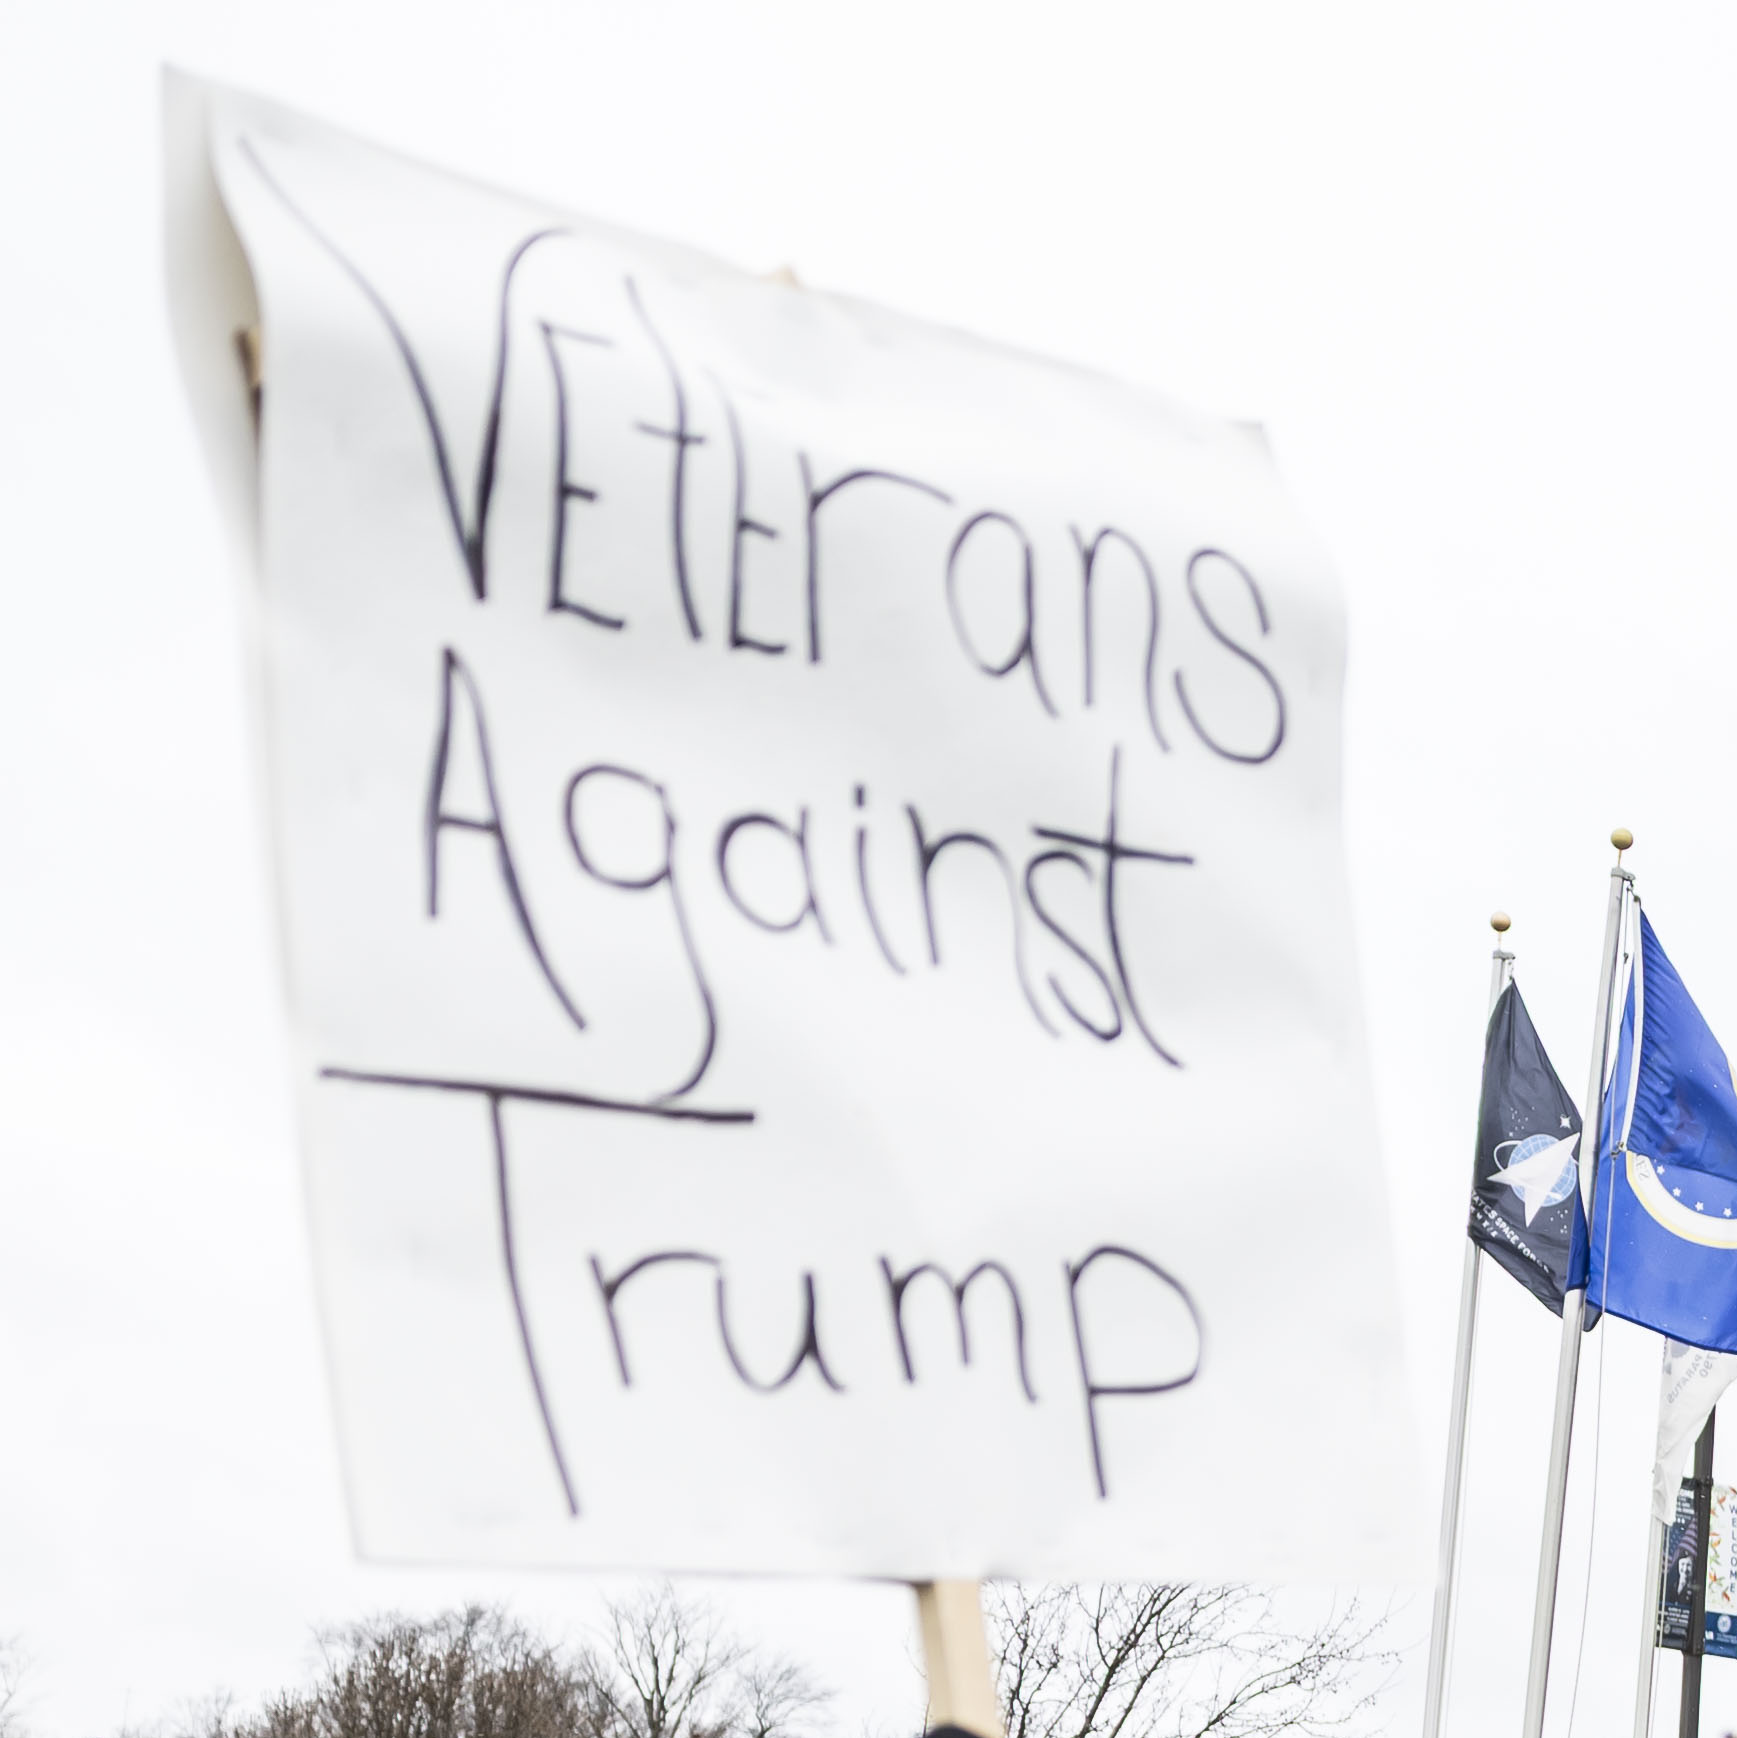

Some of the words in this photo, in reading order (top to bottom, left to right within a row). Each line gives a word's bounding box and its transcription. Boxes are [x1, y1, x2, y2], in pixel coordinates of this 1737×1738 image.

[423, 643, 1199, 1105] Against
[318, 1065, 1206, 1520] Trump
[1495, 1217, 1520, 1245] SPACE
